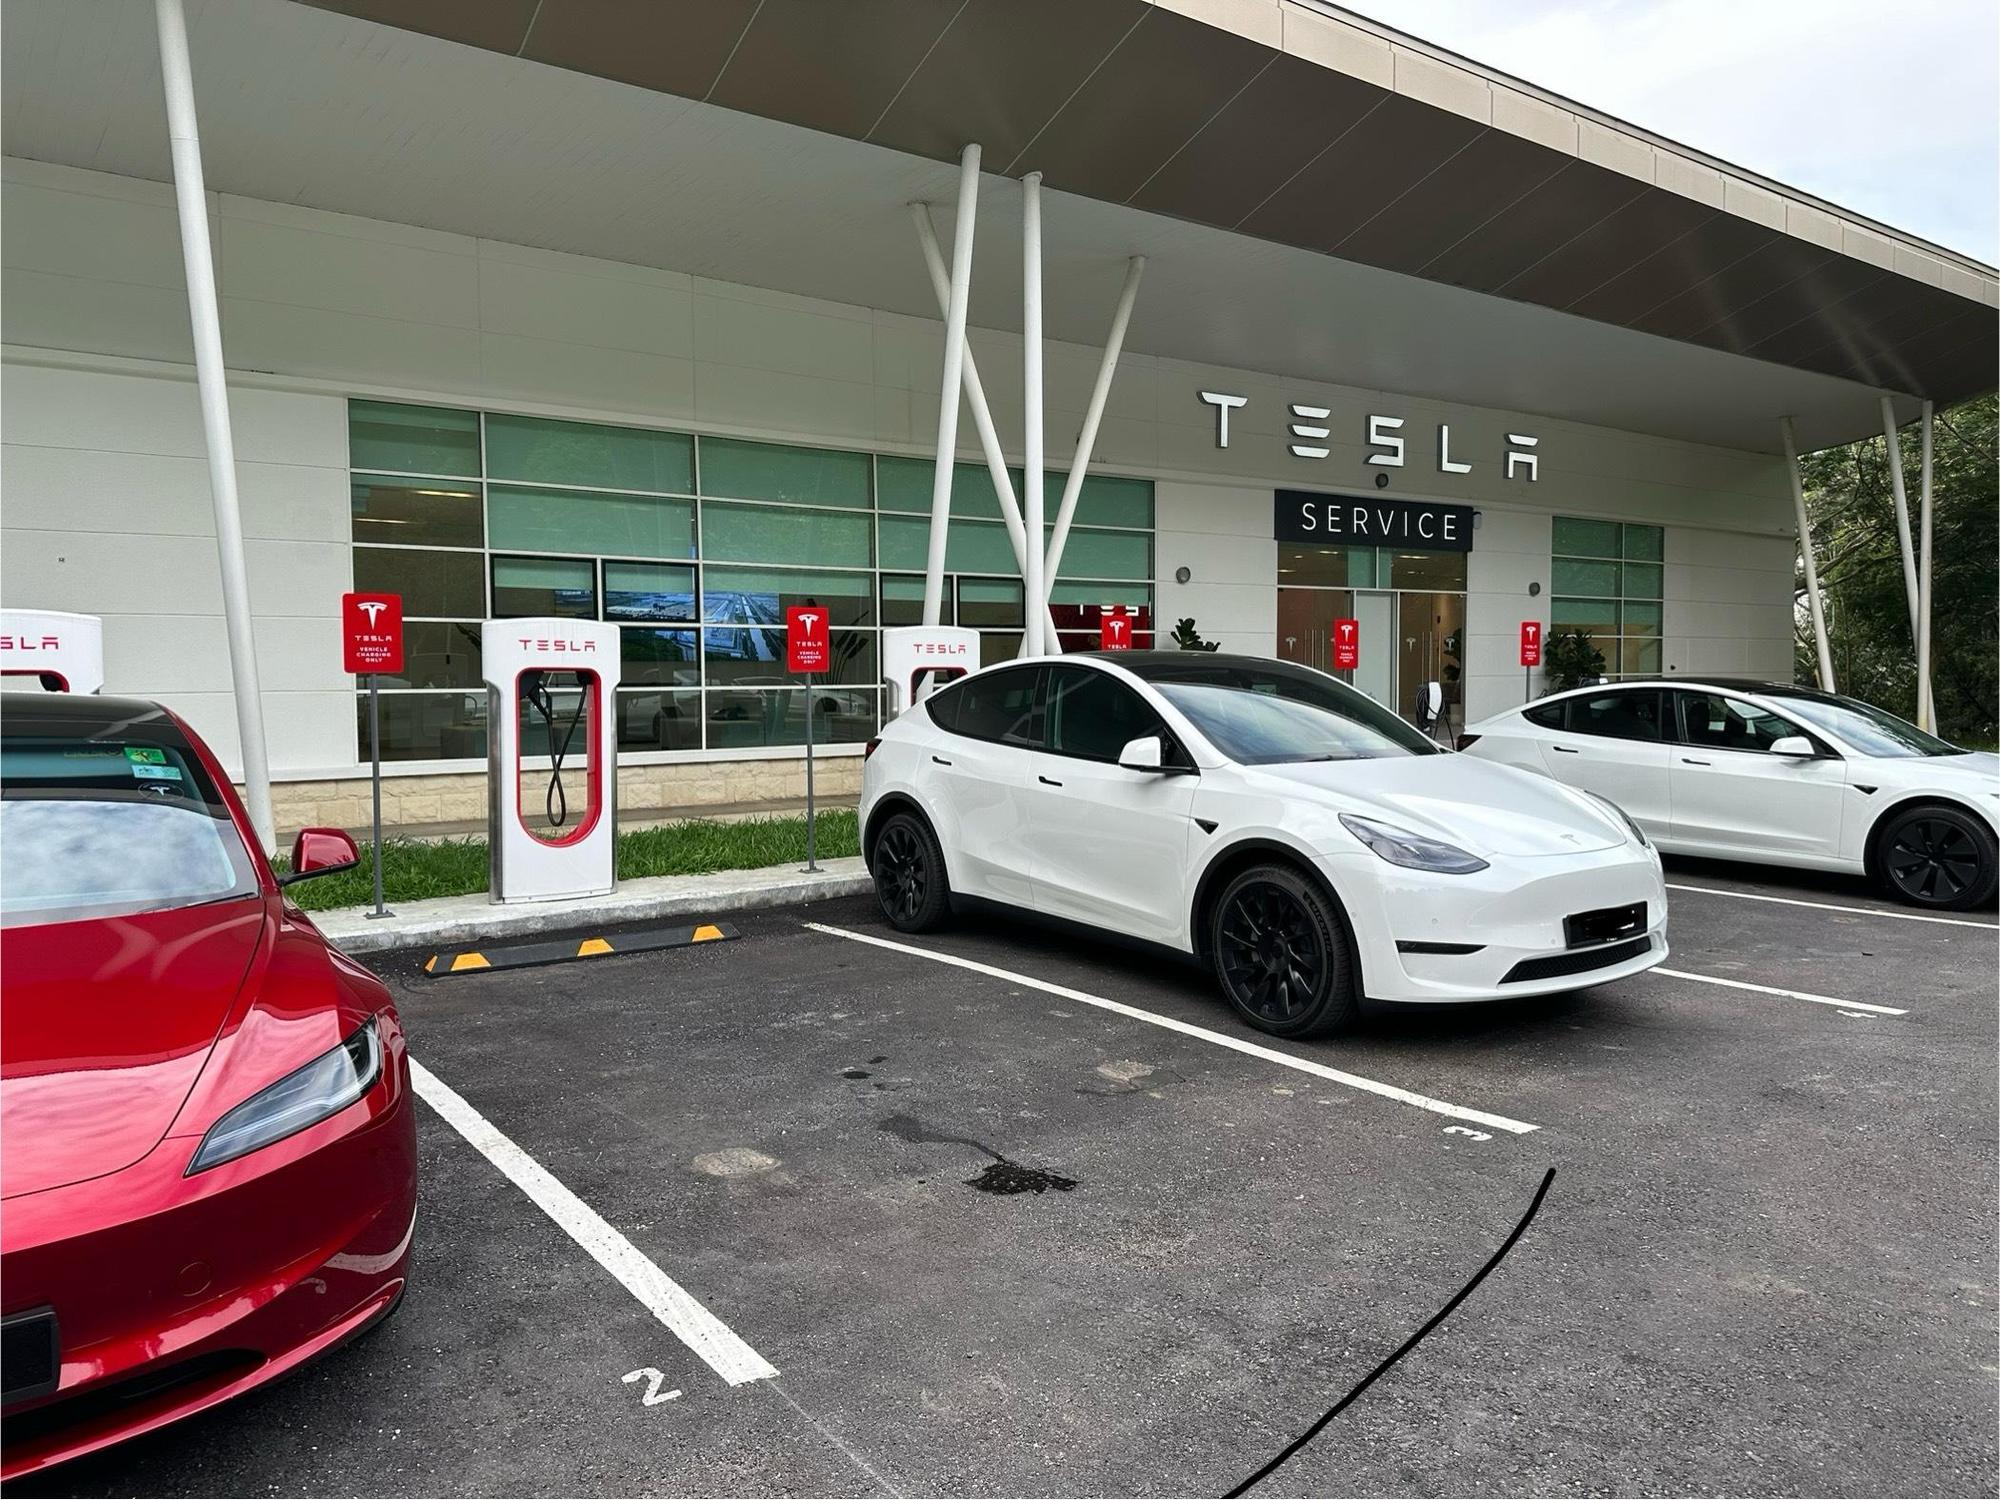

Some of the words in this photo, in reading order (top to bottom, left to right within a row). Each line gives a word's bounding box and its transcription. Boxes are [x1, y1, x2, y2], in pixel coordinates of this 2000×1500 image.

[1199, 391, 1539, 482] TESLA
[1301, 502, 1457, 541] SERVICE
[518, 639, 596, 652] TESLA
[912, 643, 967, 654] TESLA
[621, 1367, 683, 1407] 2
